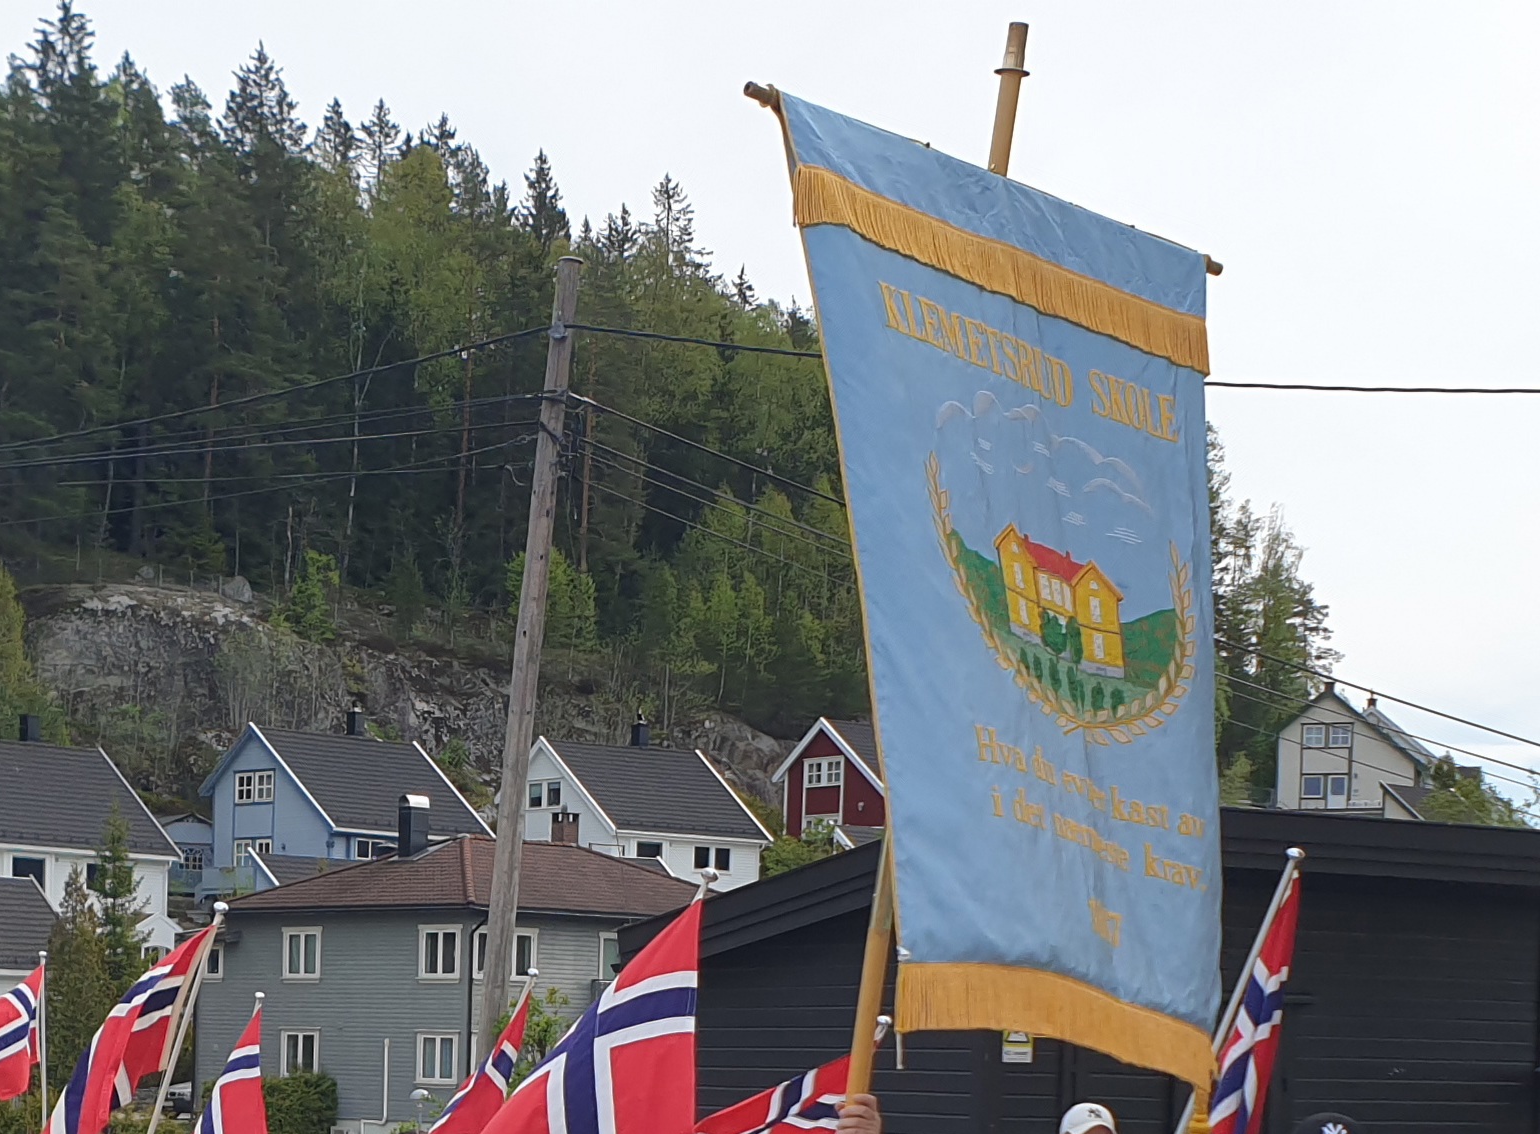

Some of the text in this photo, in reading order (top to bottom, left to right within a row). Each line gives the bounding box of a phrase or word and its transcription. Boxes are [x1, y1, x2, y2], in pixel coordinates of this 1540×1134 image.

[877, 281, 1180, 443] KLEMETSRUD SKOLE
[974, 724, 1028, 773] Hva
[1110, 785, 1170, 830] kast
[1178, 812, 1206, 839] av
[991, 784, 1005, 817] i
[1013, 787, 1047, 830] det
[1144, 842, 1208, 892] krav.
